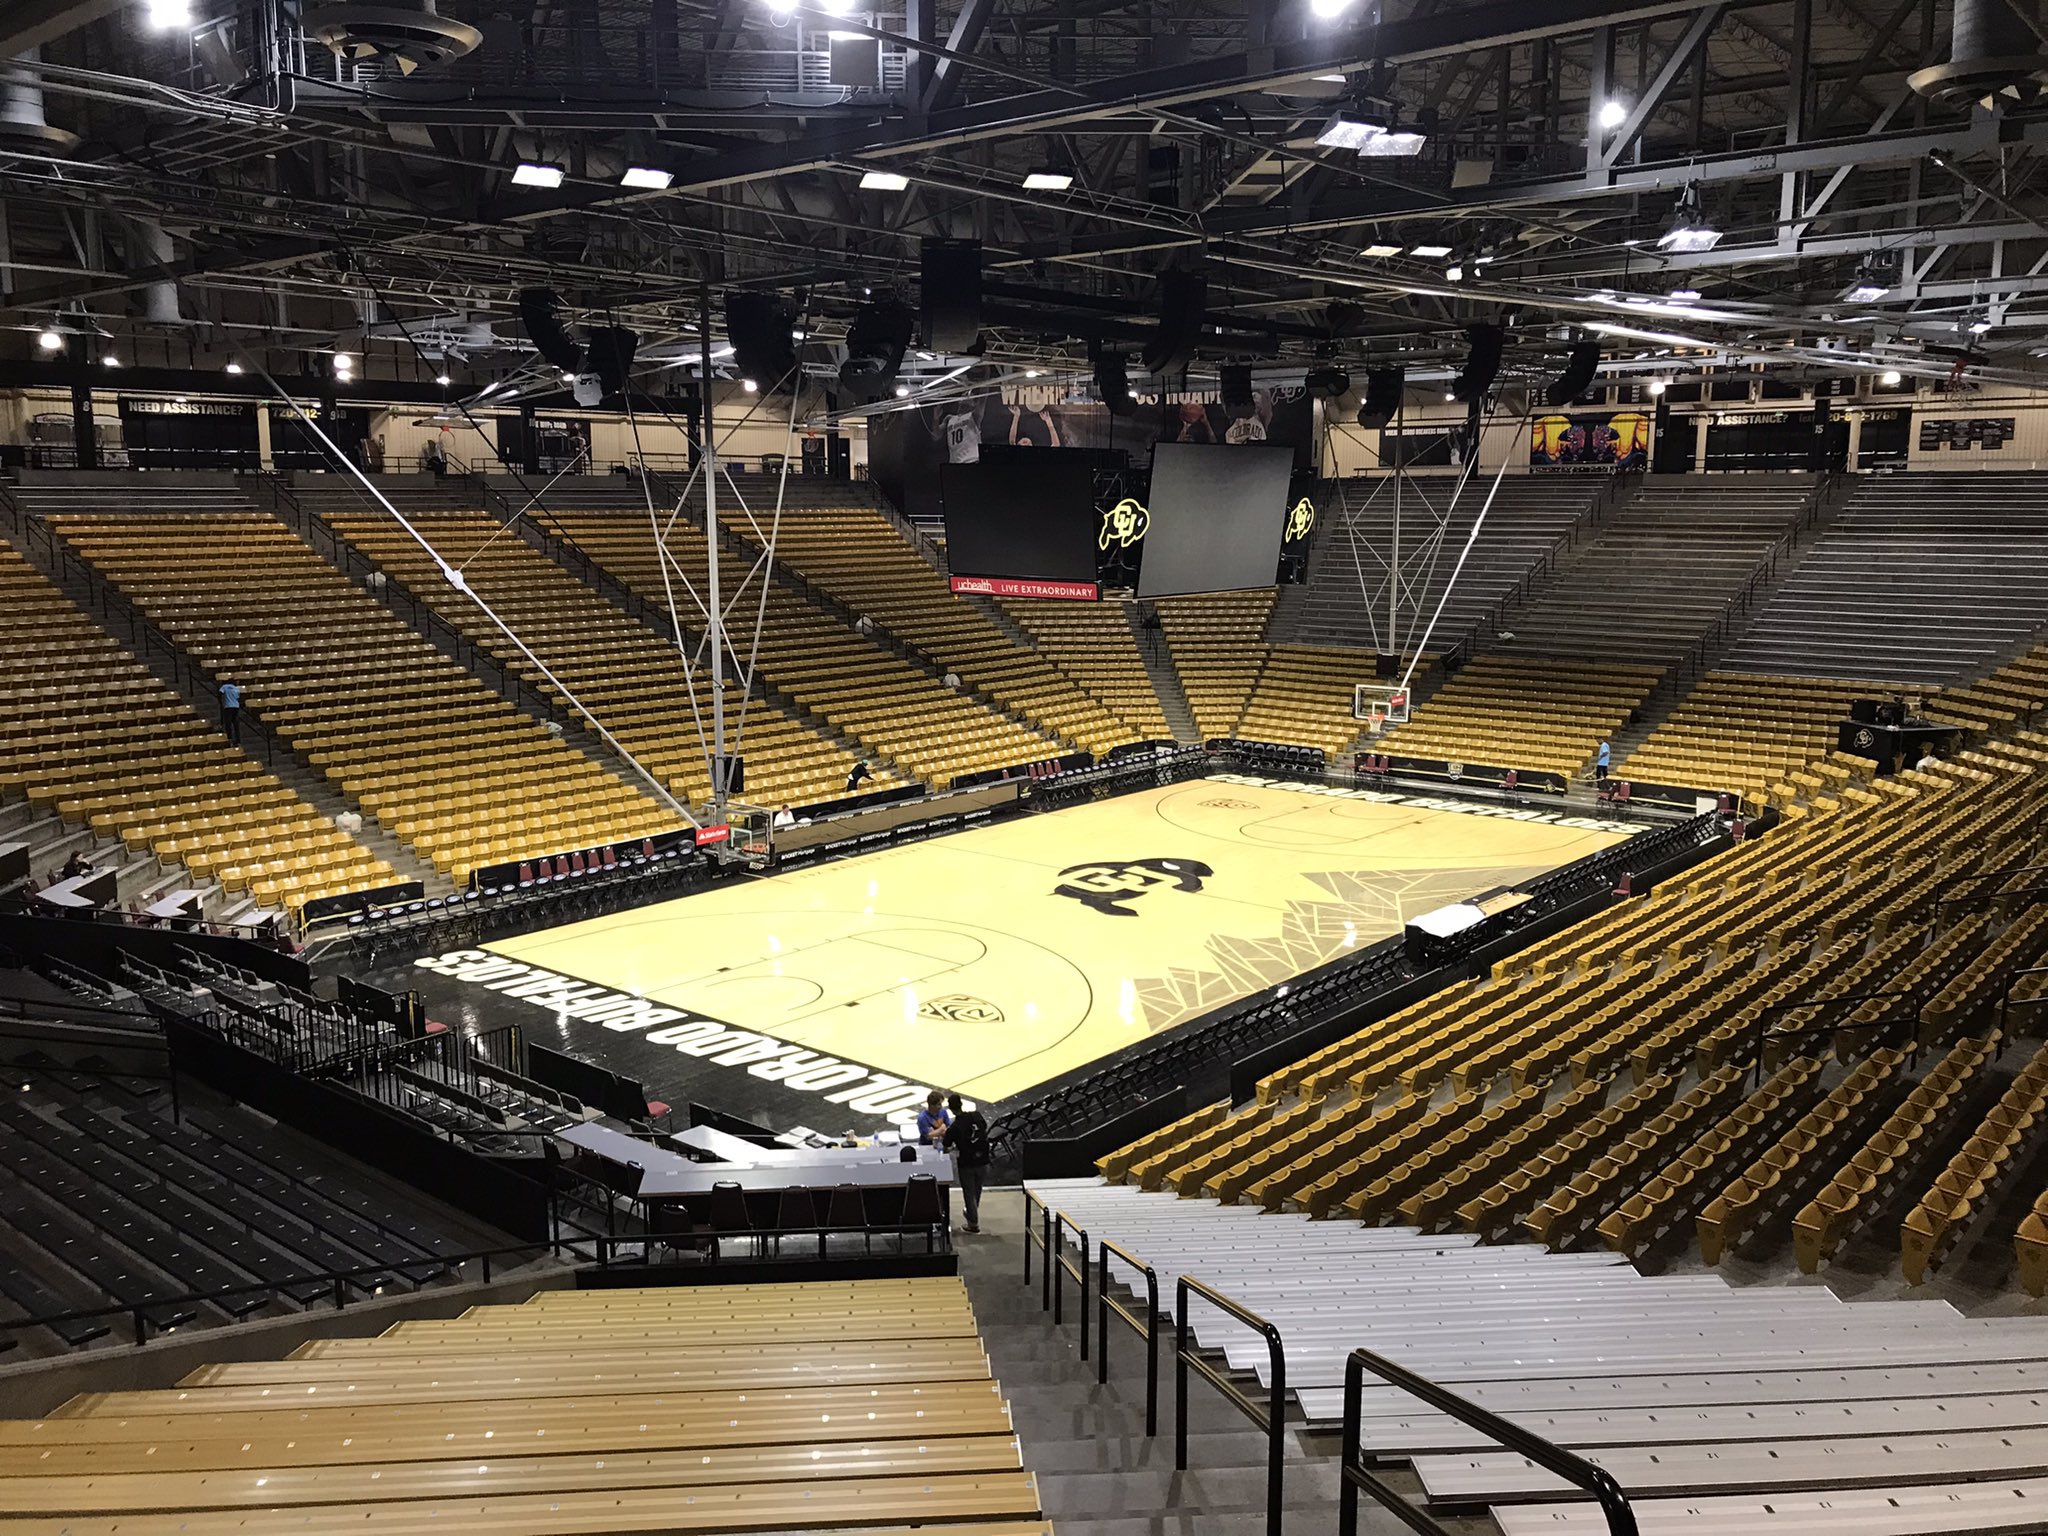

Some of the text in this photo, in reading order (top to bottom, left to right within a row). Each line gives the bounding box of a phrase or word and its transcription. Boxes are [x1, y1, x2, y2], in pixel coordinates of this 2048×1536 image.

[129, 401, 160, 412] NEED
[163, 402, 243, 415] ASSISTANCE?
[1717, 414, 1788, 425] ASSISTANCE?
[951, 428, 963, 445] 10
[957, 579, 1093, 597] uchealth LIVE EXTRAORDINARY
[1205, 774, 1652, 835] COLORADO BUFFALOES
[414, 950, 689, 1032] BUFFALOES
